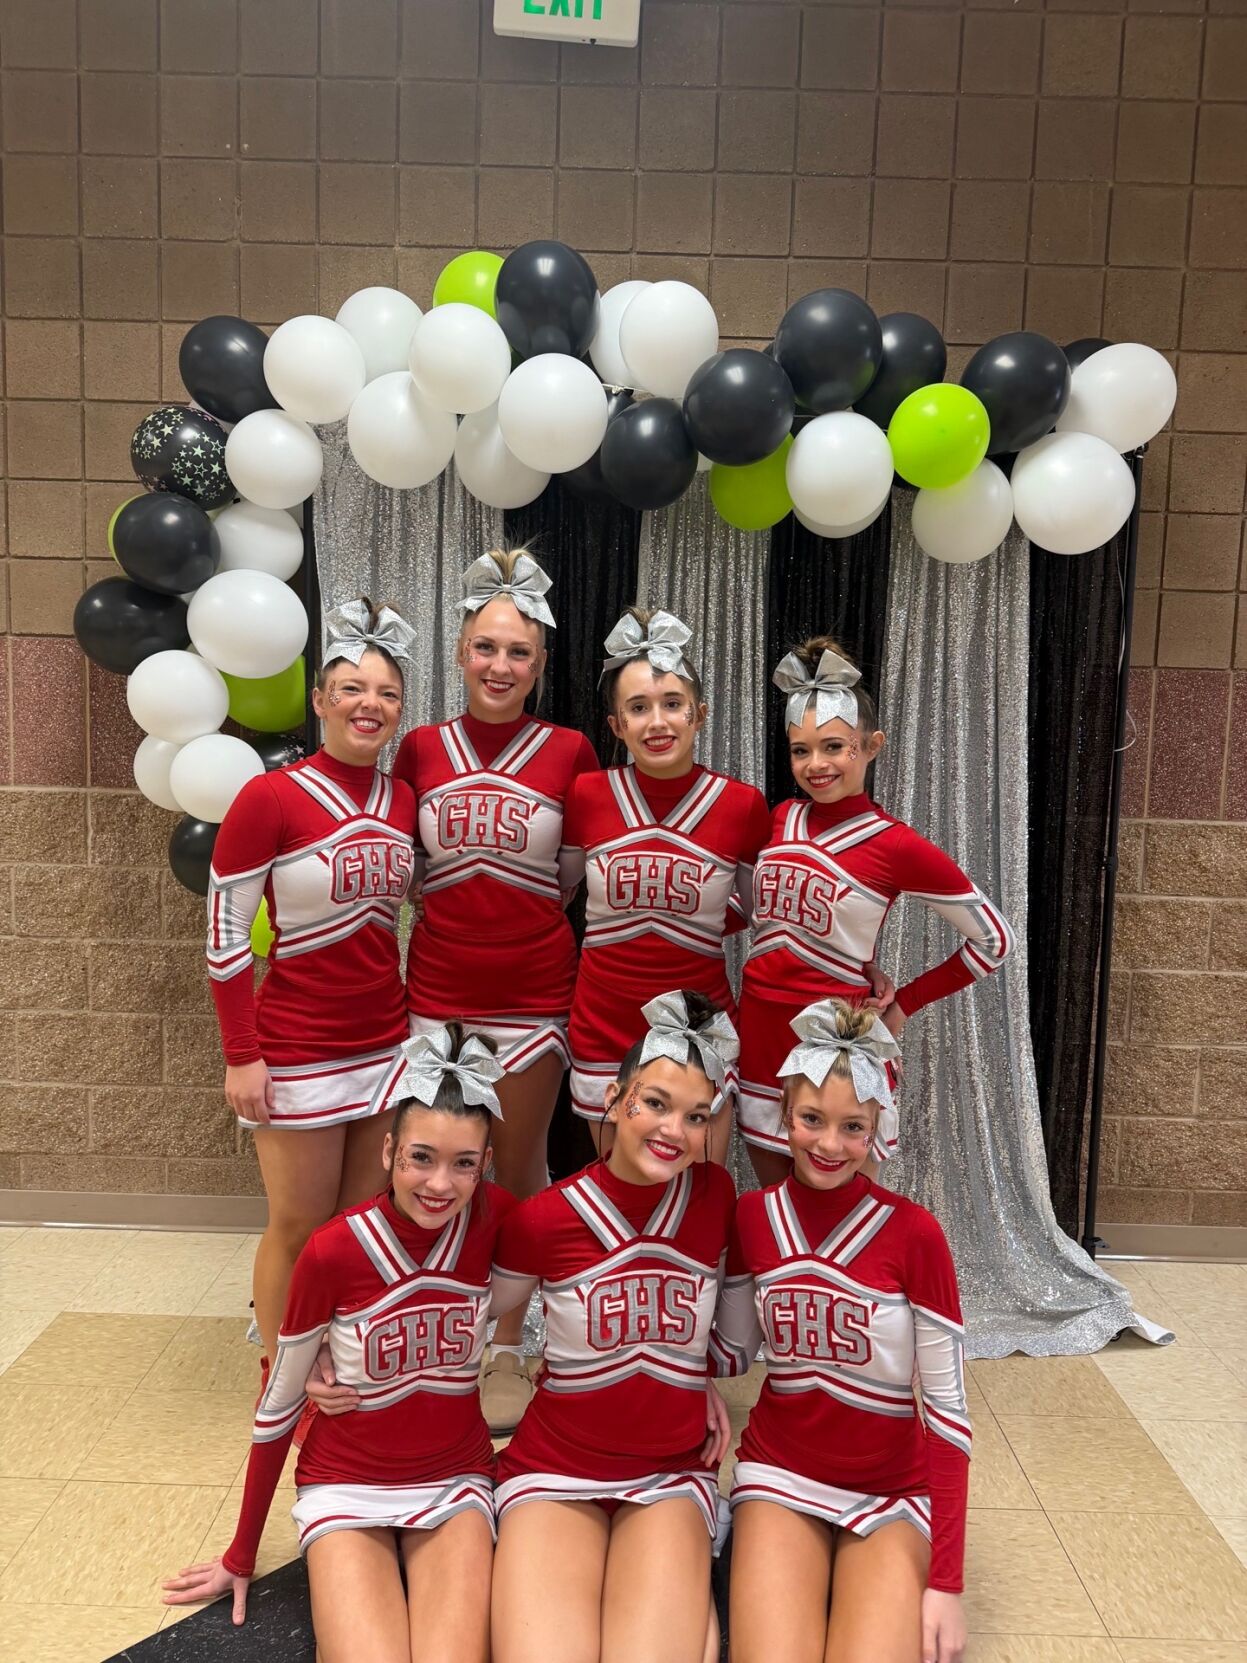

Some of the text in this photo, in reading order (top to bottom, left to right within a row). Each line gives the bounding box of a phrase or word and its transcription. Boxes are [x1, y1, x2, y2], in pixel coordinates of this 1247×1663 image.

[438, 796, 528, 849] GHS
[330, 845, 411, 901] GHS
[606, 853, 700, 912] GHS
[753, 863, 836, 934] GHS
[366, 1307, 474, 1379] GHS
[588, 1276, 697, 1349] GHS
[764, 1290, 870, 1364] GHS
